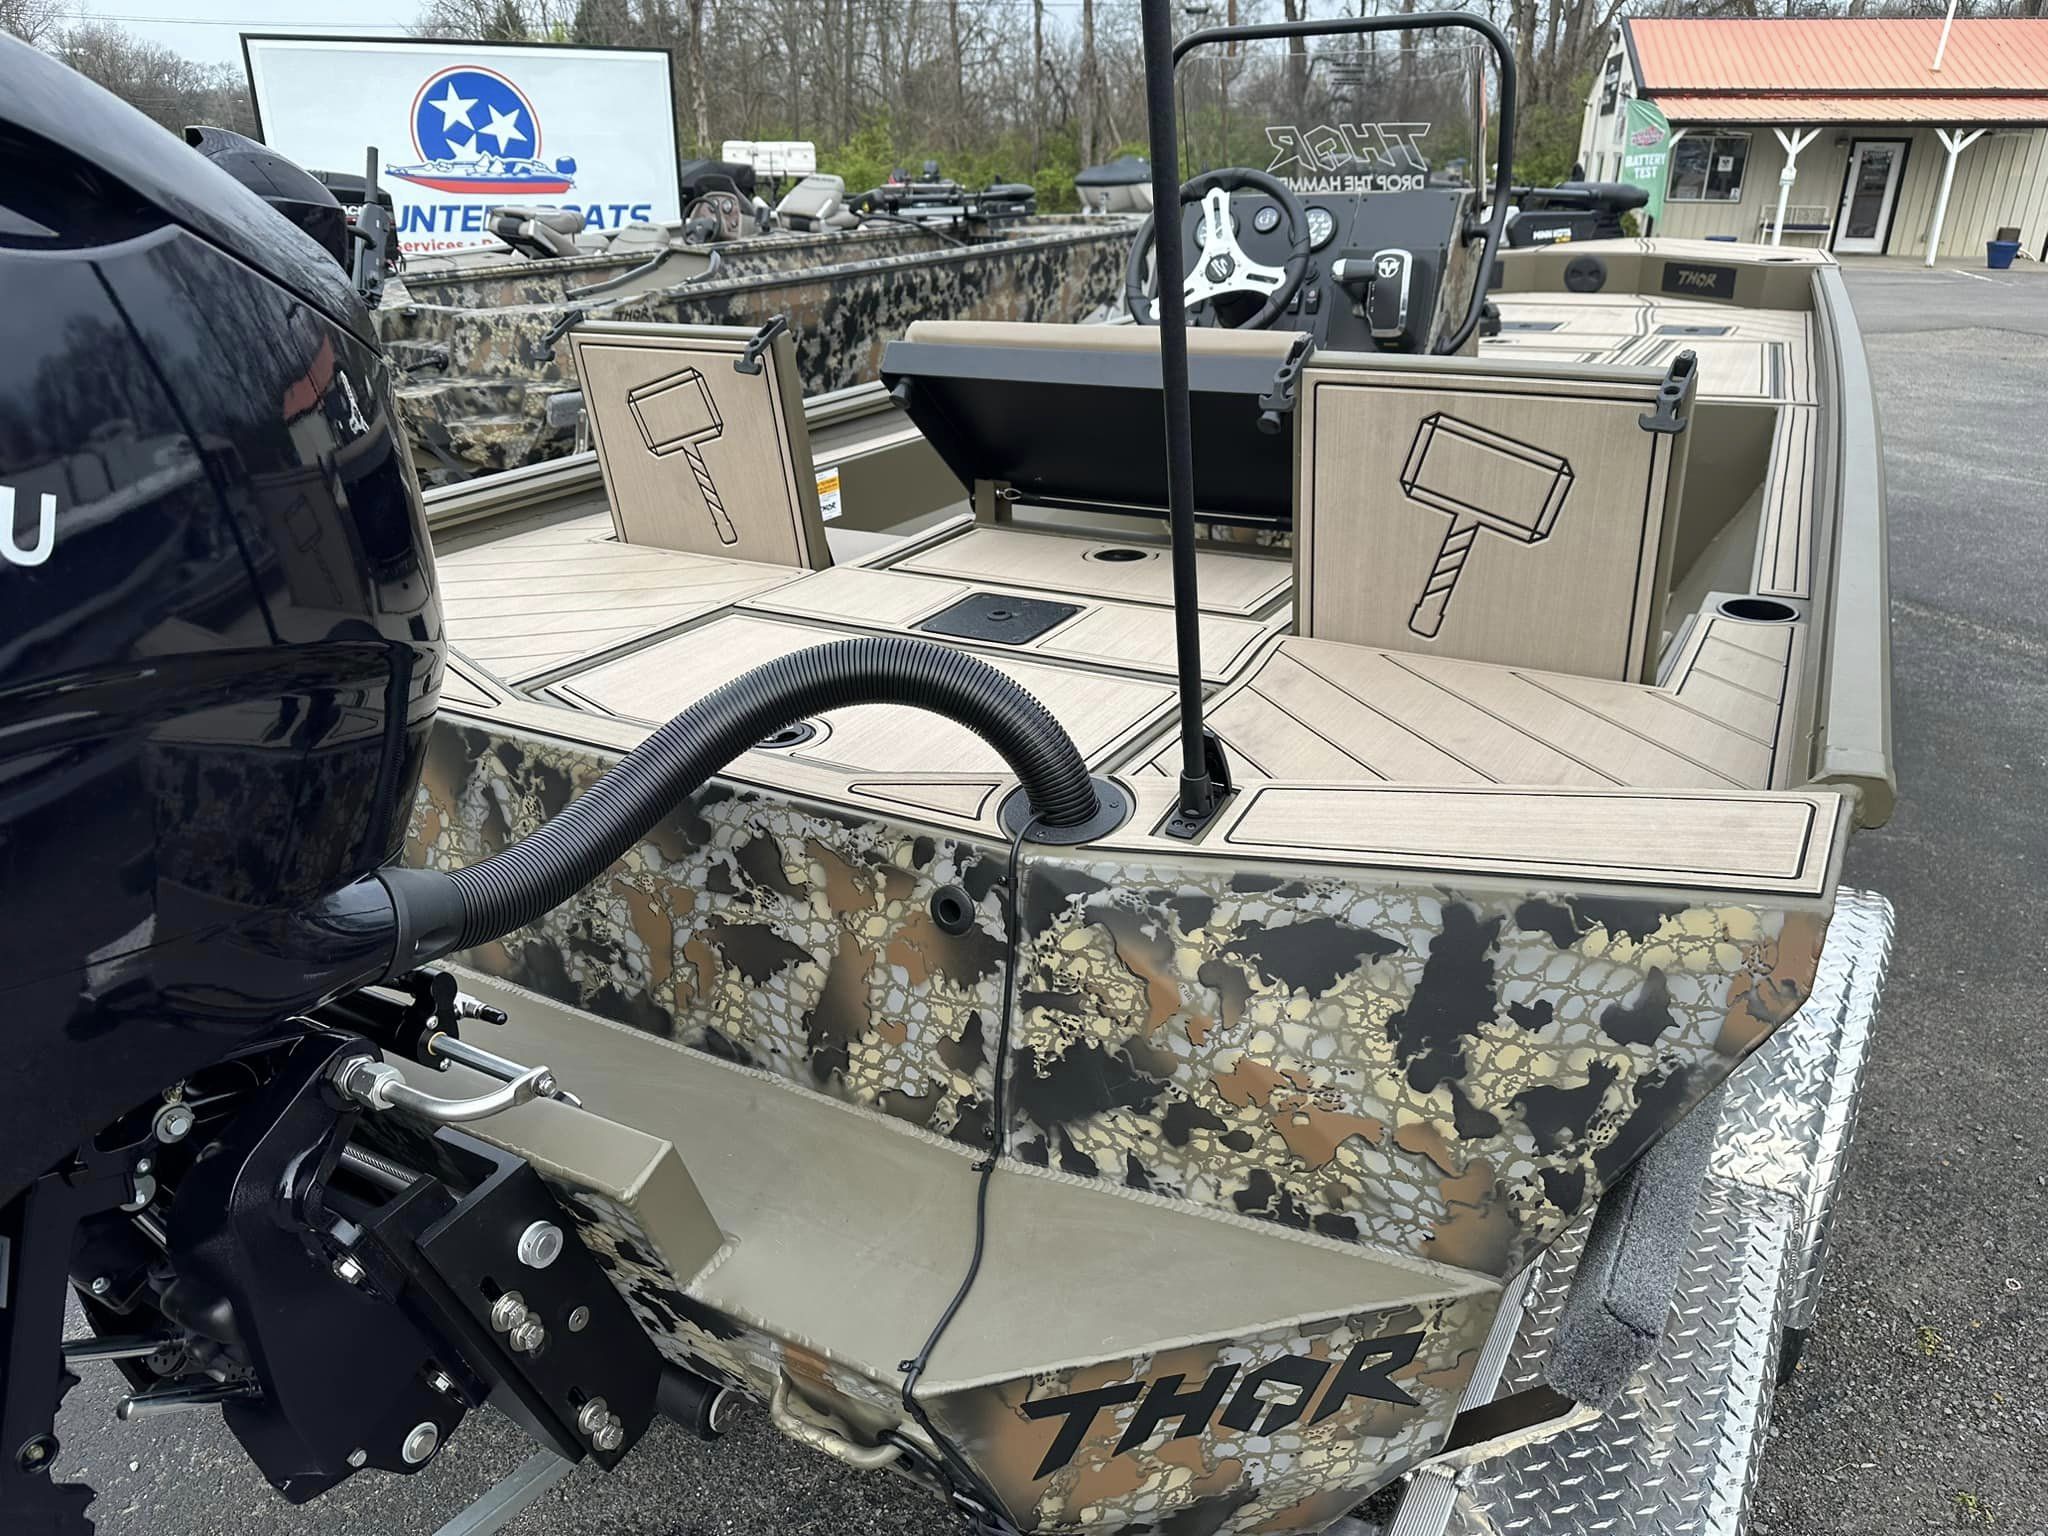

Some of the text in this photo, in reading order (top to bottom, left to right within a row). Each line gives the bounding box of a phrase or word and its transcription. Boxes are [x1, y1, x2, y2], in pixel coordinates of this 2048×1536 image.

[1635, 167, 1658, 179] TEST
[1678, 270, 1718, 288] THOR
[1020, 1331, 1427, 1481] THOR
